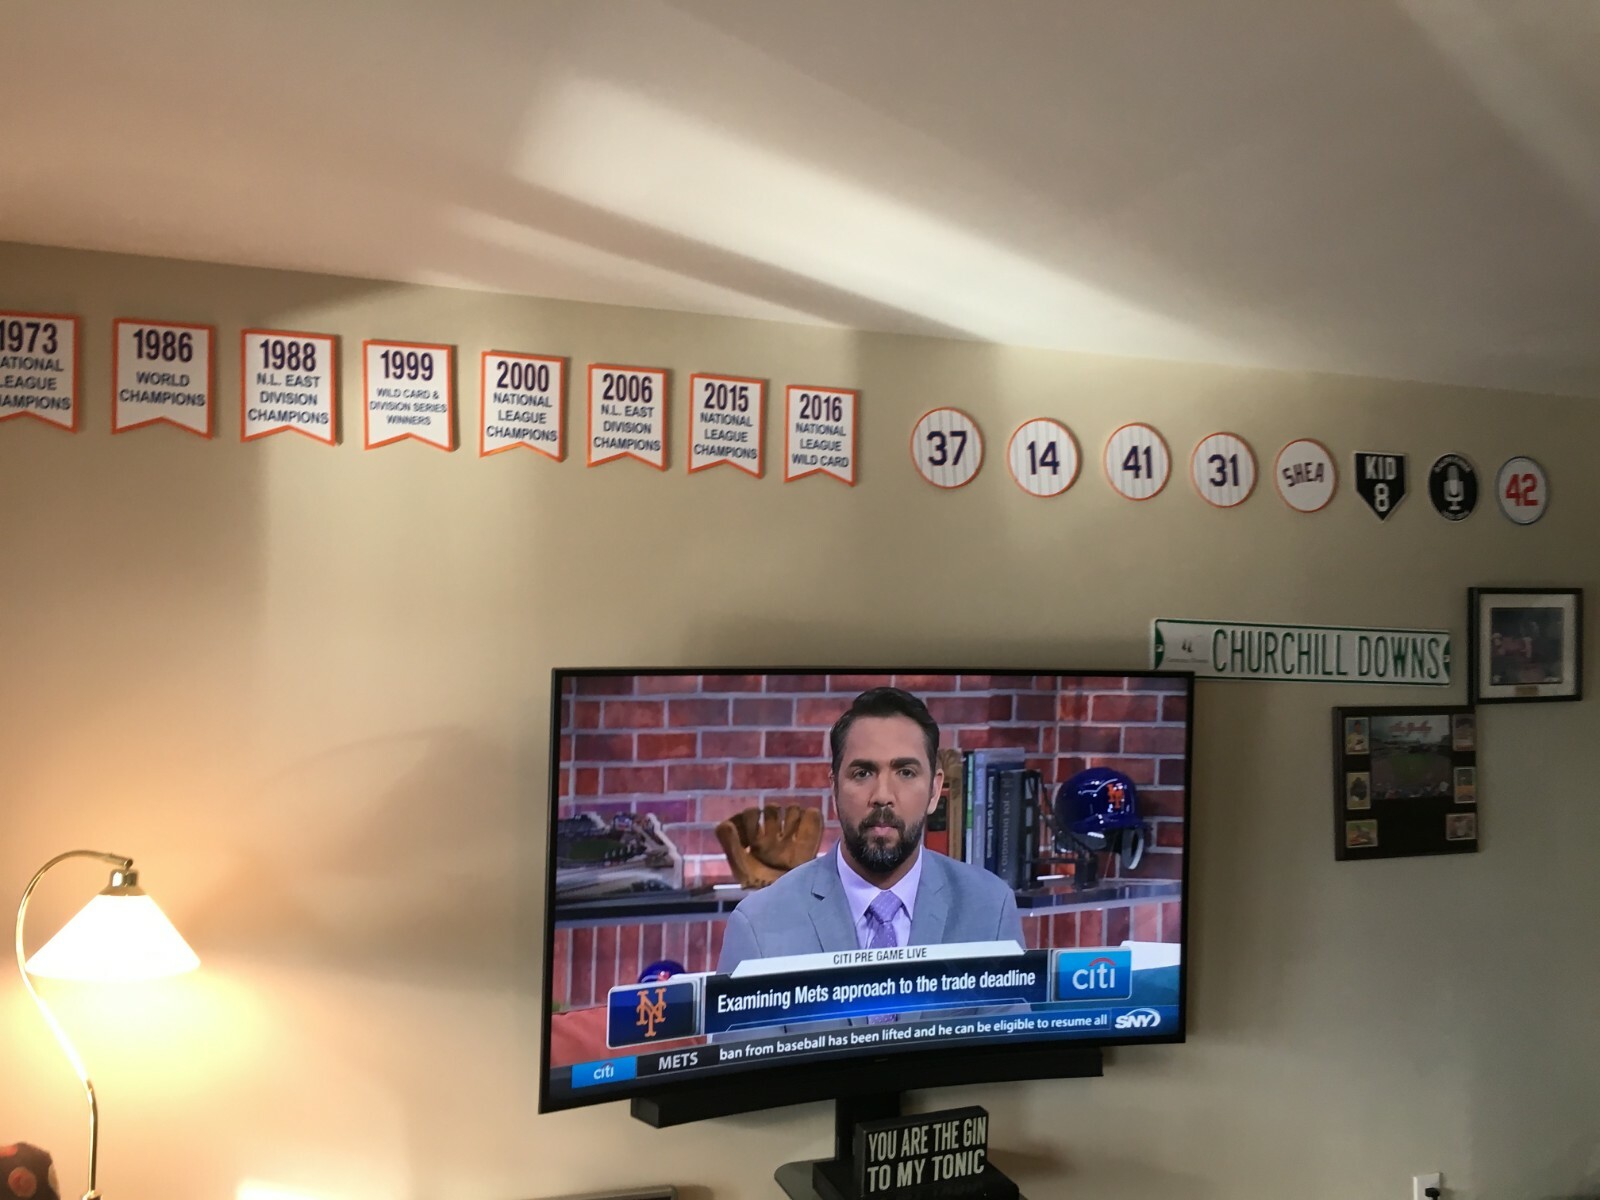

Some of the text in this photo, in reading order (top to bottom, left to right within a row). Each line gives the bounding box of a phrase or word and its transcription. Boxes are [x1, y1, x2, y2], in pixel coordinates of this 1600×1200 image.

[0, 319, 58, 354] 1973
[133, 328, 193, 363] 1986
[0, 356, 64, 372] ATIONAL
[259, 339, 317, 372] 1988
[380, 350, 434, 381] 1999
[136, 371, 190, 387] WORLD
[256, 373, 321, 388] N.L. EAST
[496, 361, 549, 392] 2000
[119, 388, 206, 407] CHAMPIONS
[376, 388, 400, 399] WILD
[402, 389, 431, 399] CARD
[602, 373, 653, 403] 2006
[704, 382, 748, 412] 2015
[0, 394, 71, 410] AMPIONS
[259, 391, 318, 405] DIVISION
[369, 401, 447, 413] DIVISION SERIES
[493, 392, 552, 408] NATIONAL
[800, 393, 842, 422] 2016
[248, 409, 329, 424] CHAMPIONS
[386, 415, 431, 425] WINNERS
[498, 410, 547, 424] LEAGUE
[600, 403, 654, 418] N.L. EAST
[700, 412, 753, 427] NATIONAL
[486, 425, 557, 442] CHAMPIONS
[603, 420, 651, 434] DIVISION
[704, 428, 748, 442] LEAGUE
[795, 422, 846, 437] NATIONAL
[593, 436, 661, 451] CHAMPIONS
[693, 443, 757, 460] CHAMPIONS
[800, 438, 842, 451] LEAGUE
[926, 430, 967, 466] 37
[791, 453, 849, 468] WILD CARD
[1026, 441, 1060, 475] 14
[1122, 445, 1152, 479] 41
[1365, 455, 1396, 480] KID
[1208, 453, 1239, 487] 31
[1282, 461, 1325, 487] SHEA
[1374, 483, 1390, 512] 8
[1505, 473, 1538, 506] 42
[1212, 628, 1440, 680] CHURCHILL DOWNS
[833, 948, 927, 965] CITI PRE GAME LIVE
[1072, 960, 1116, 990] citi
[717, 969, 1035, 1013] Examining Mets approach to the trade deadline
[1115, 1009, 1160, 1029] SNY
[719, 1014, 1107, 1061] ban from baseball has been lifted and he can be eligible to resume all
[593, 1062, 614, 1080] citi
[658, 1052, 698, 1071] METS
[868, 1116, 987, 1162] YOU ARE THE GIN
[867, 1149, 985, 1192] TO MY TONIC
